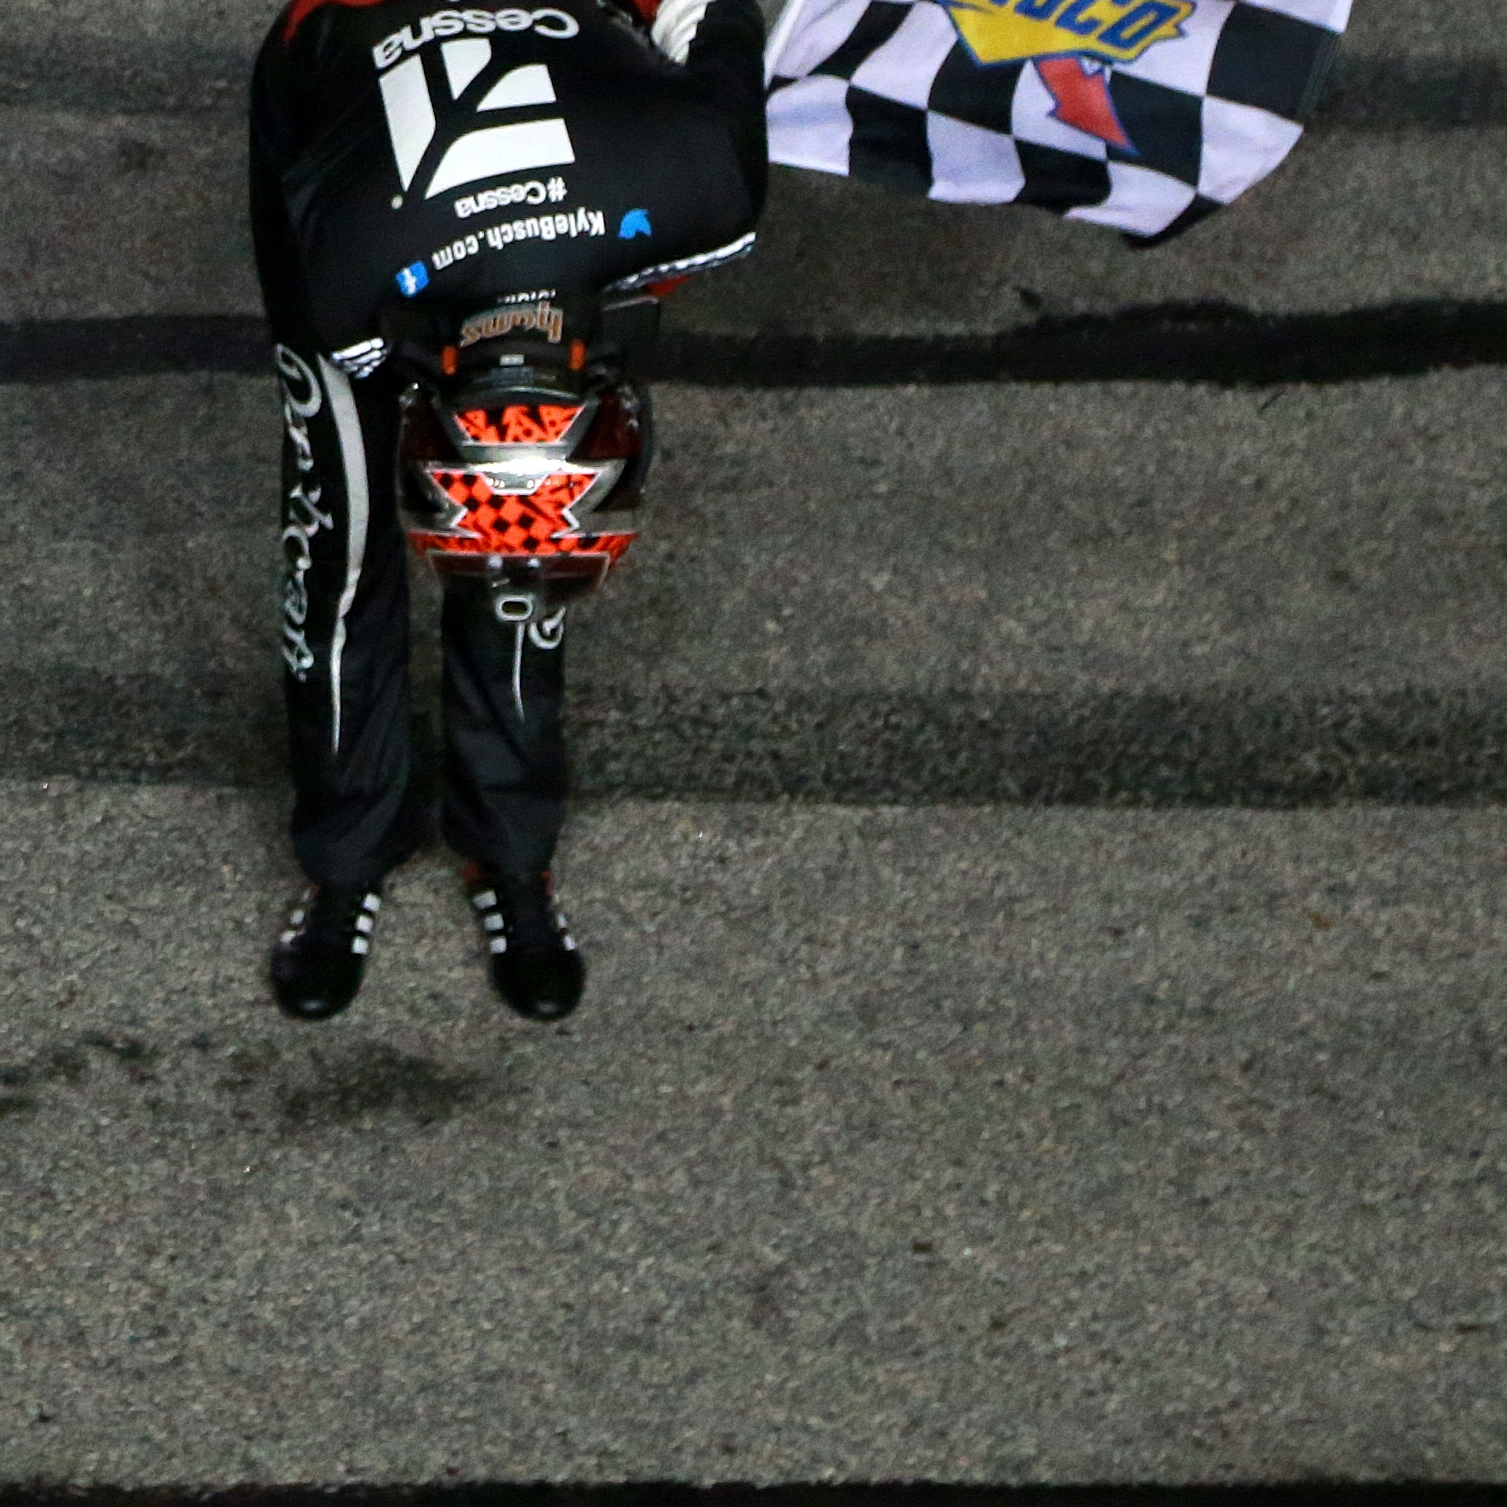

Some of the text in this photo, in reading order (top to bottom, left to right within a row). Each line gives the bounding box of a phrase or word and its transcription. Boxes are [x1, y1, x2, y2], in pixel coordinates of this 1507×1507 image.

[371, 6, 580, 70] Cessna
[454, 177, 567, 219] #Cessna
[432, 209, 606, 271] KyleBusch.com
